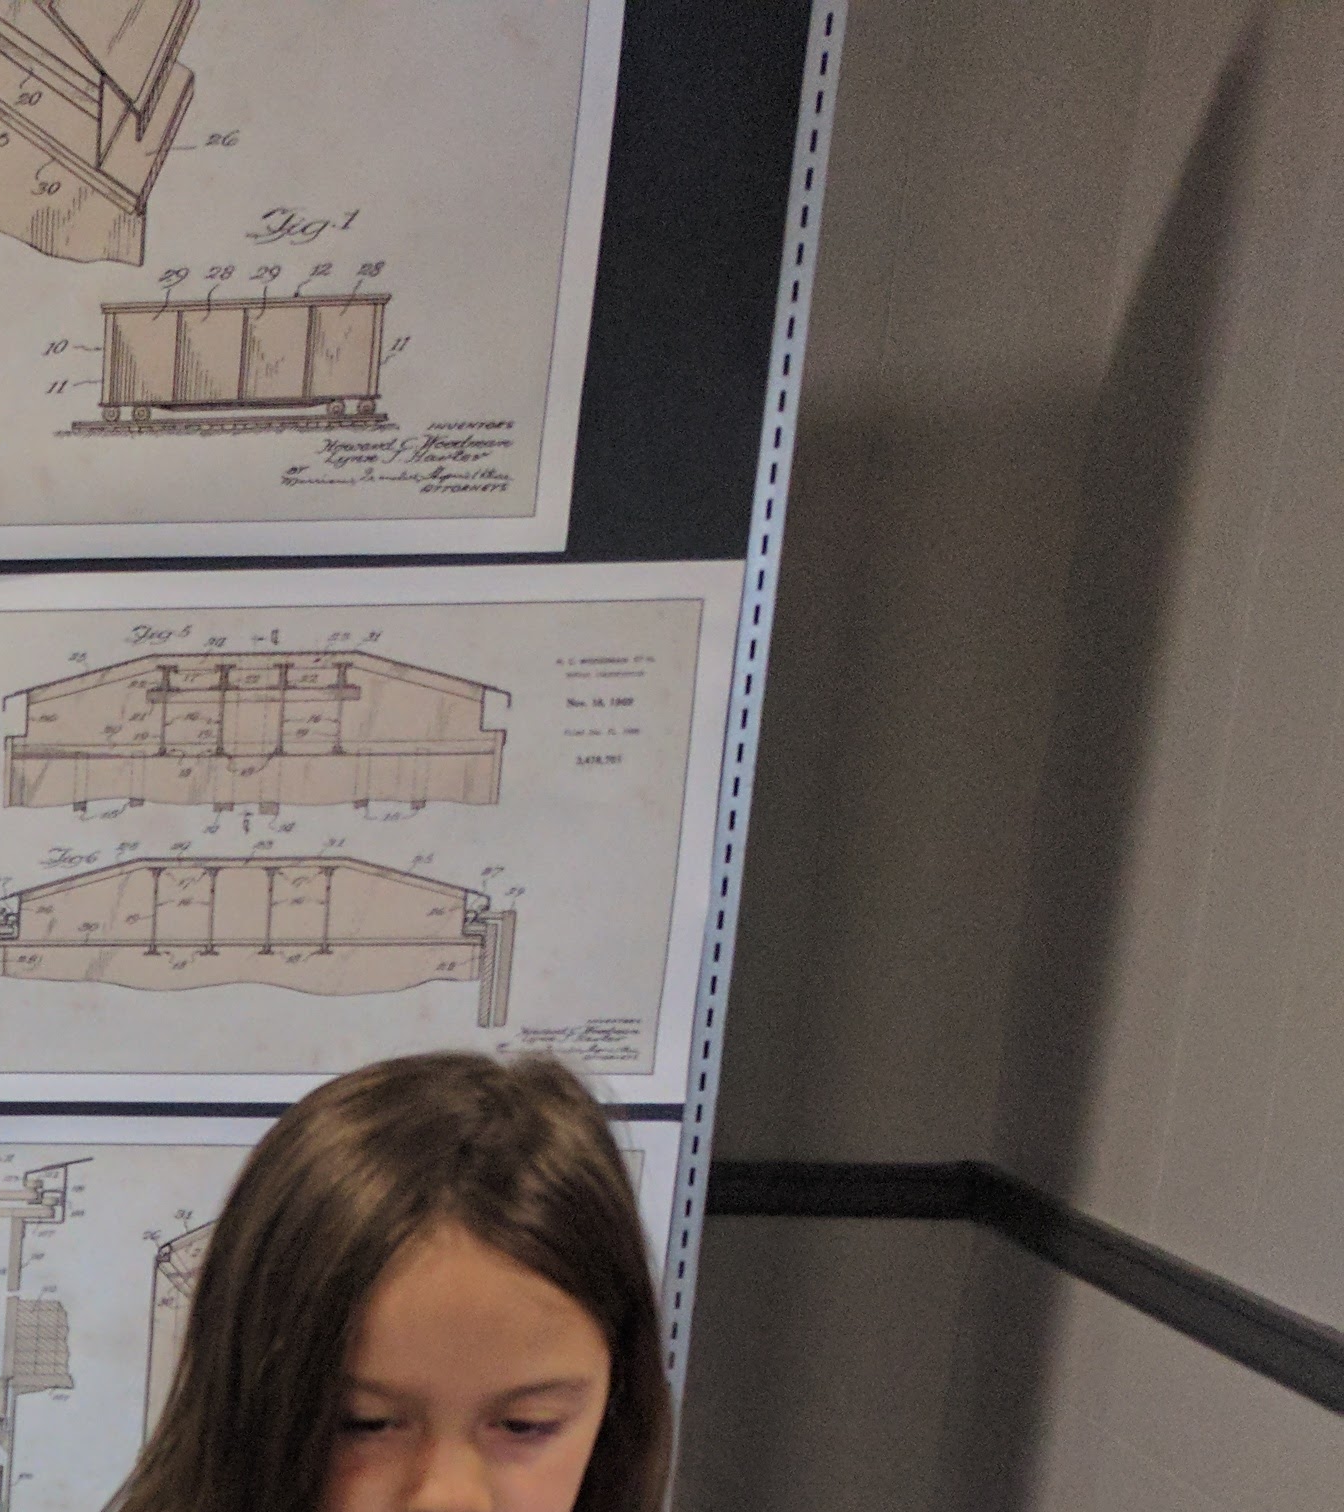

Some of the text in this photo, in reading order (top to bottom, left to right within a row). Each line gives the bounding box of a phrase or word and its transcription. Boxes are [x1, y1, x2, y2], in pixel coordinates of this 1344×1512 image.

[204, 129, 240, 148] 26
[30, 181, 62, 196] 30
[158, 267, 190, 287] 29
[204, 264, 236, 280] 28
[248, 265, 281, 281] 29
[309, 262, 333, 277] 12
[356, 260, 385, 278] 28
[42, 339, 69, 356] 10
